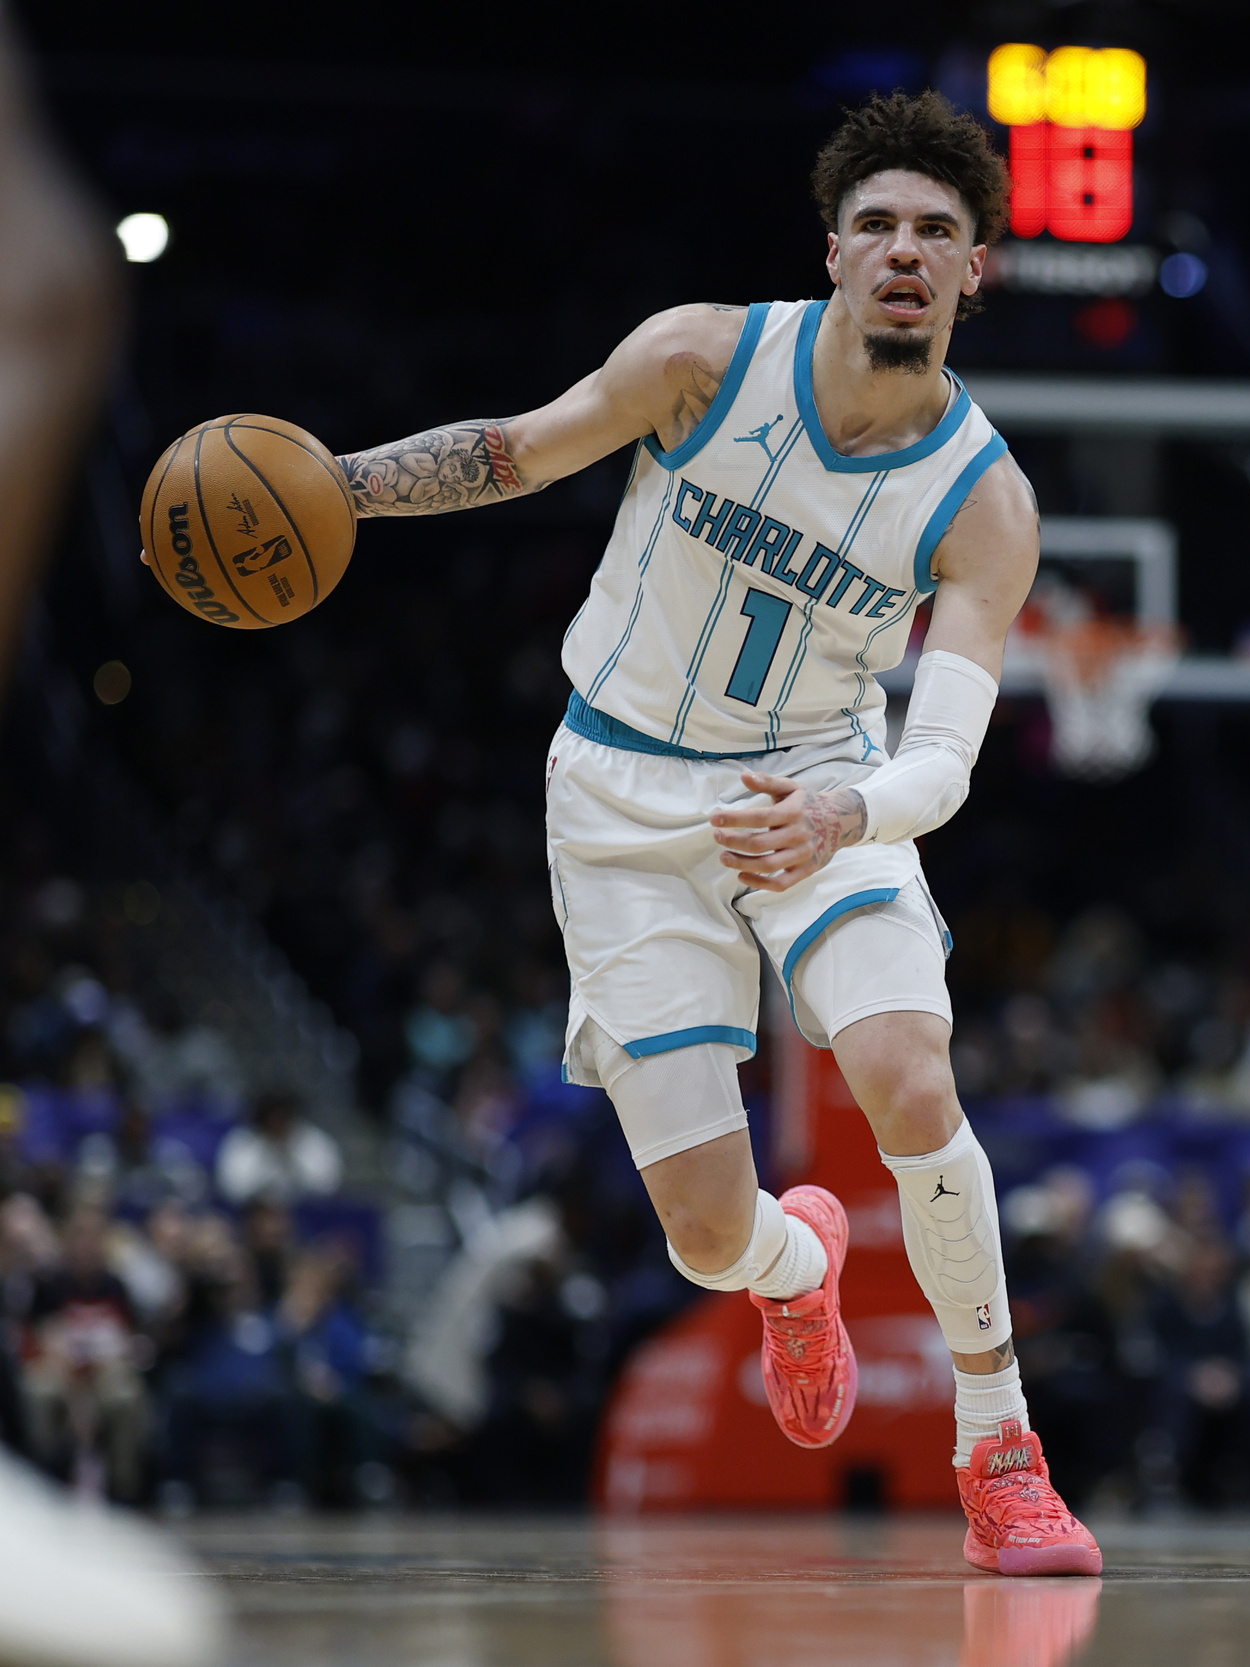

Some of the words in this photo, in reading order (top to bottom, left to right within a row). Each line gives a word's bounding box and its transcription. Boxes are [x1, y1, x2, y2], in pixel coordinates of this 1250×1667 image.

[168, 501, 240, 624] Wilson
[672, 478, 906, 618] CHARLOTTE
[724, 587, 793, 707] 1
